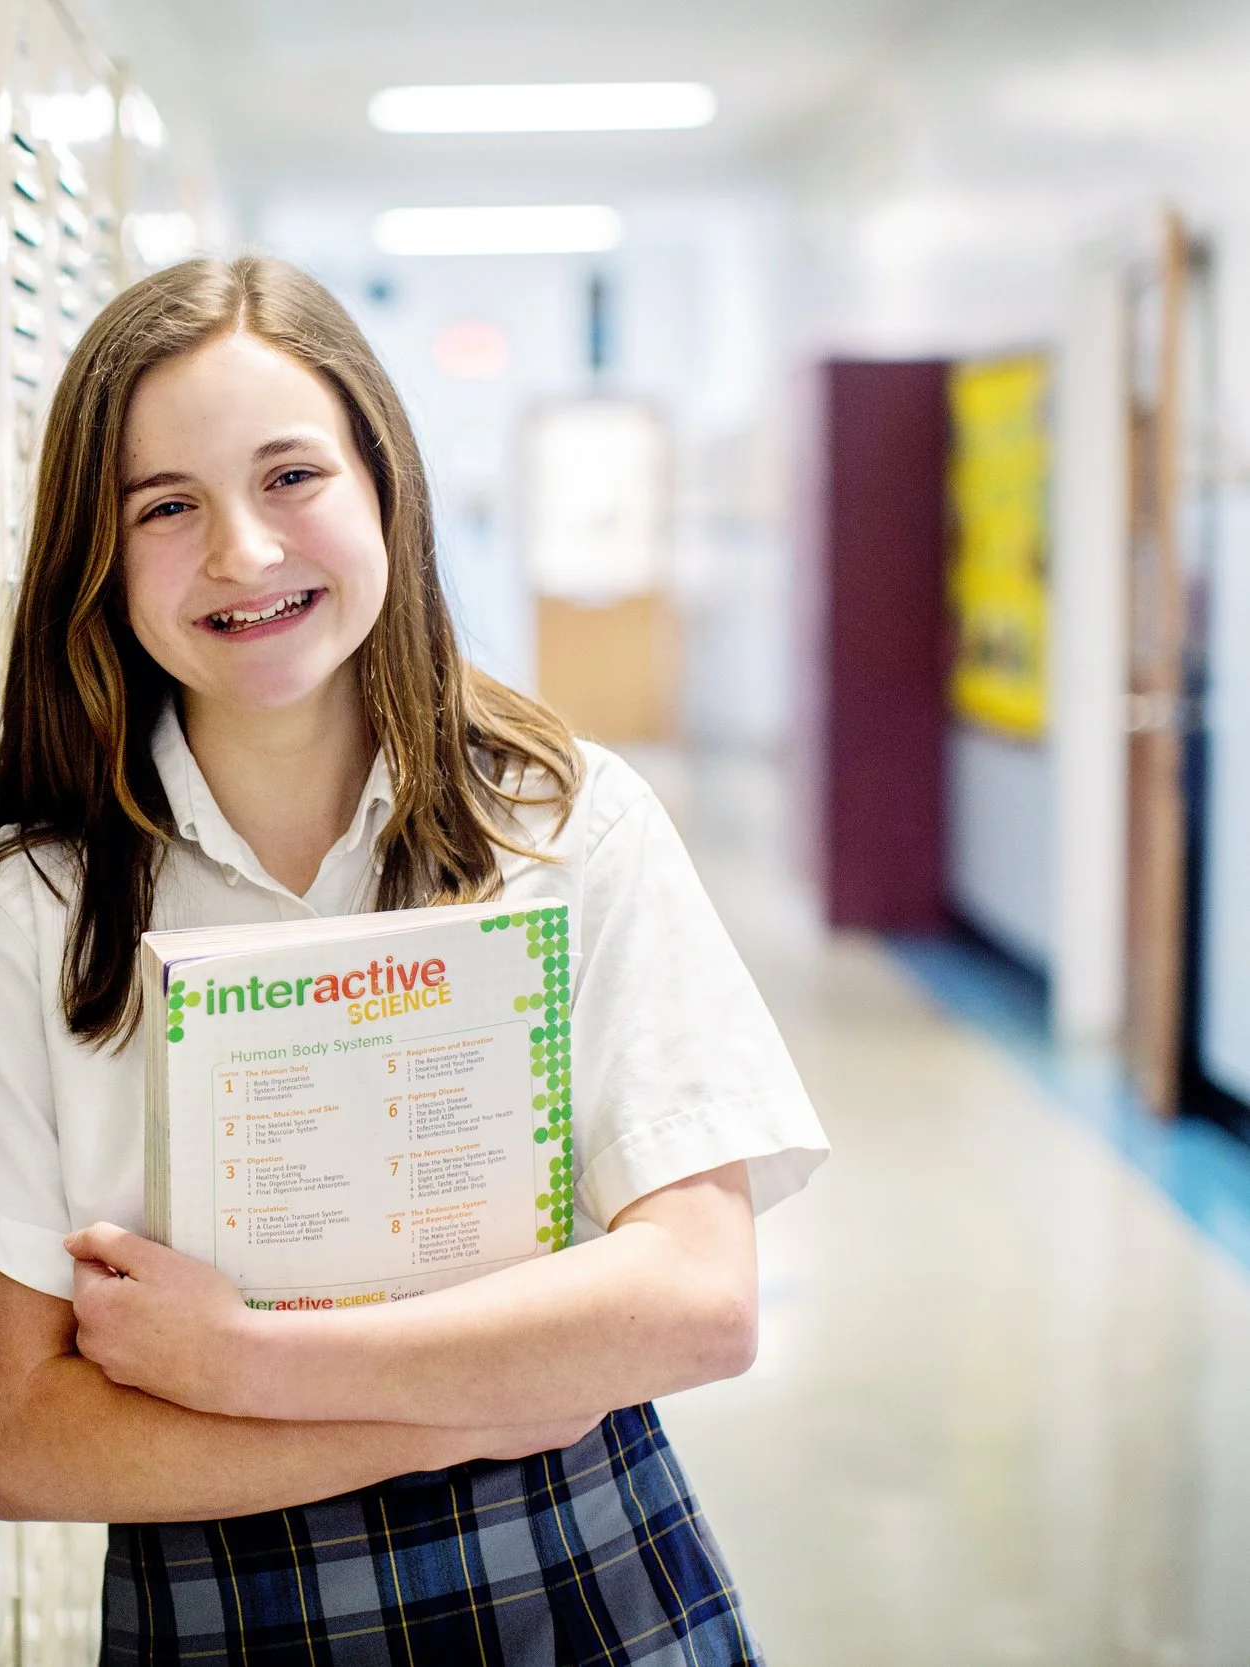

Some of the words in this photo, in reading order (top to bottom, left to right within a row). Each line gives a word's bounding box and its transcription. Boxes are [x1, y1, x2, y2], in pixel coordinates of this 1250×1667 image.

[207, 955, 446, 1015] interactive
[347, 982, 453, 1025] SCIENCE
[231, 1048, 286, 1064] Human
[293, 1043, 328, 1058] Body
[334, 1034, 393, 1052] Systems
[407, 1046, 446, 1057] Respiration
[462, 1037, 494, 1047] Excretion
[427, 1053, 458, 1064] Respiratory
[460, 1050, 479, 1059] System
[290, 1065, 309, 1073] Body
[388, 1060, 397, 1074] 5
[415, 1065, 438, 1073] Smoking
[427, 1069, 452, 1079] Excretory
[455, 1066, 474, 1075] System
[225, 1079, 233, 1093] 1
[271, 1075, 310, 1084] Organization
[278, 1082, 314, 1091] Interactions
[254, 1093, 292, 1101] Homeostasis
[408, 1090, 436, 1101] Fighting
[439, 1086, 465, 1096] Disease
[416, 1100, 444, 1109] Infectious
[447, 1096, 468, 1105] Disease
[274, 1110, 306, 1119] Muscles,
[389, 1103, 397, 1117] 6
[428, 1107, 446, 1116] Body's
[448, 1103, 473, 1112] Defenses
[417, 1123, 445, 1132] Infectious
[448, 1118, 469, 1127] Disease
[496, 1110, 513, 1118] Health
[226, 1123, 234, 1136] 2
[268, 1128, 294, 1136] Muscular
[297, 1126, 318, 1134] System
[417, 1131, 456, 1140] Noninfectious
[458, 1125, 478, 1134] Disease
[425, 1148, 453, 1157] Nervous
[455, 1143, 480, 1152] System
[247, 1156, 284, 1164] Digestion
[443, 1156, 465, 1164] Nervous
[467, 1153, 486, 1161] System
[226, 1165, 235, 1179] 3
[286, 1163, 306, 1171] Energy
[391, 1162, 398, 1176] 7
[418, 1167, 443, 1175] Divisions
[464, 1160, 485, 1168] Nervous
[488, 1156, 506, 1164] System
[256, 1173, 279, 1181] Healthy
[282, 1171, 301, 1179] Eating
[269, 1179, 297, 1188] Digestive
[324, 1174, 344, 1182] Begins
[418, 1176, 432, 1184] Sight
[447, 1170, 469, 1179] Hearing
[274, 1186, 302, 1194] Digestion
[318, 1180, 350, 1190] Absorption
[471, 1182, 486, 1190] Drugs
[426, 1205, 460, 1214] Endocrine
[462, 1199, 487, 1209] System
[226, 1215, 236, 1228] 4
[270, 1214, 289, 1223] Body's
[292, 1210, 319, 1220] Transport
[322, 1209, 342, 1218] System
[329, 1216, 349, 1224] Vessels
[426, 1211, 472, 1223] Reproduction
[392, 1220, 400, 1233] 8
[431, 1223, 458, 1232] Endocrine
[460, 1220, 480, 1228] System
[458, 1227, 477, 1235] Female
[257, 1229, 294, 1238] Composition
[257, 1236, 300, 1244] Cardiovascular
[420, 1239, 456, 1249] Reproductive
[458, 1235, 480, 1244] Systems
[420, 1248, 448, 1257] Pregnancy
[244, 1296, 333, 1311] teractive
[335, 1291, 386, 1308] SCIENCE
